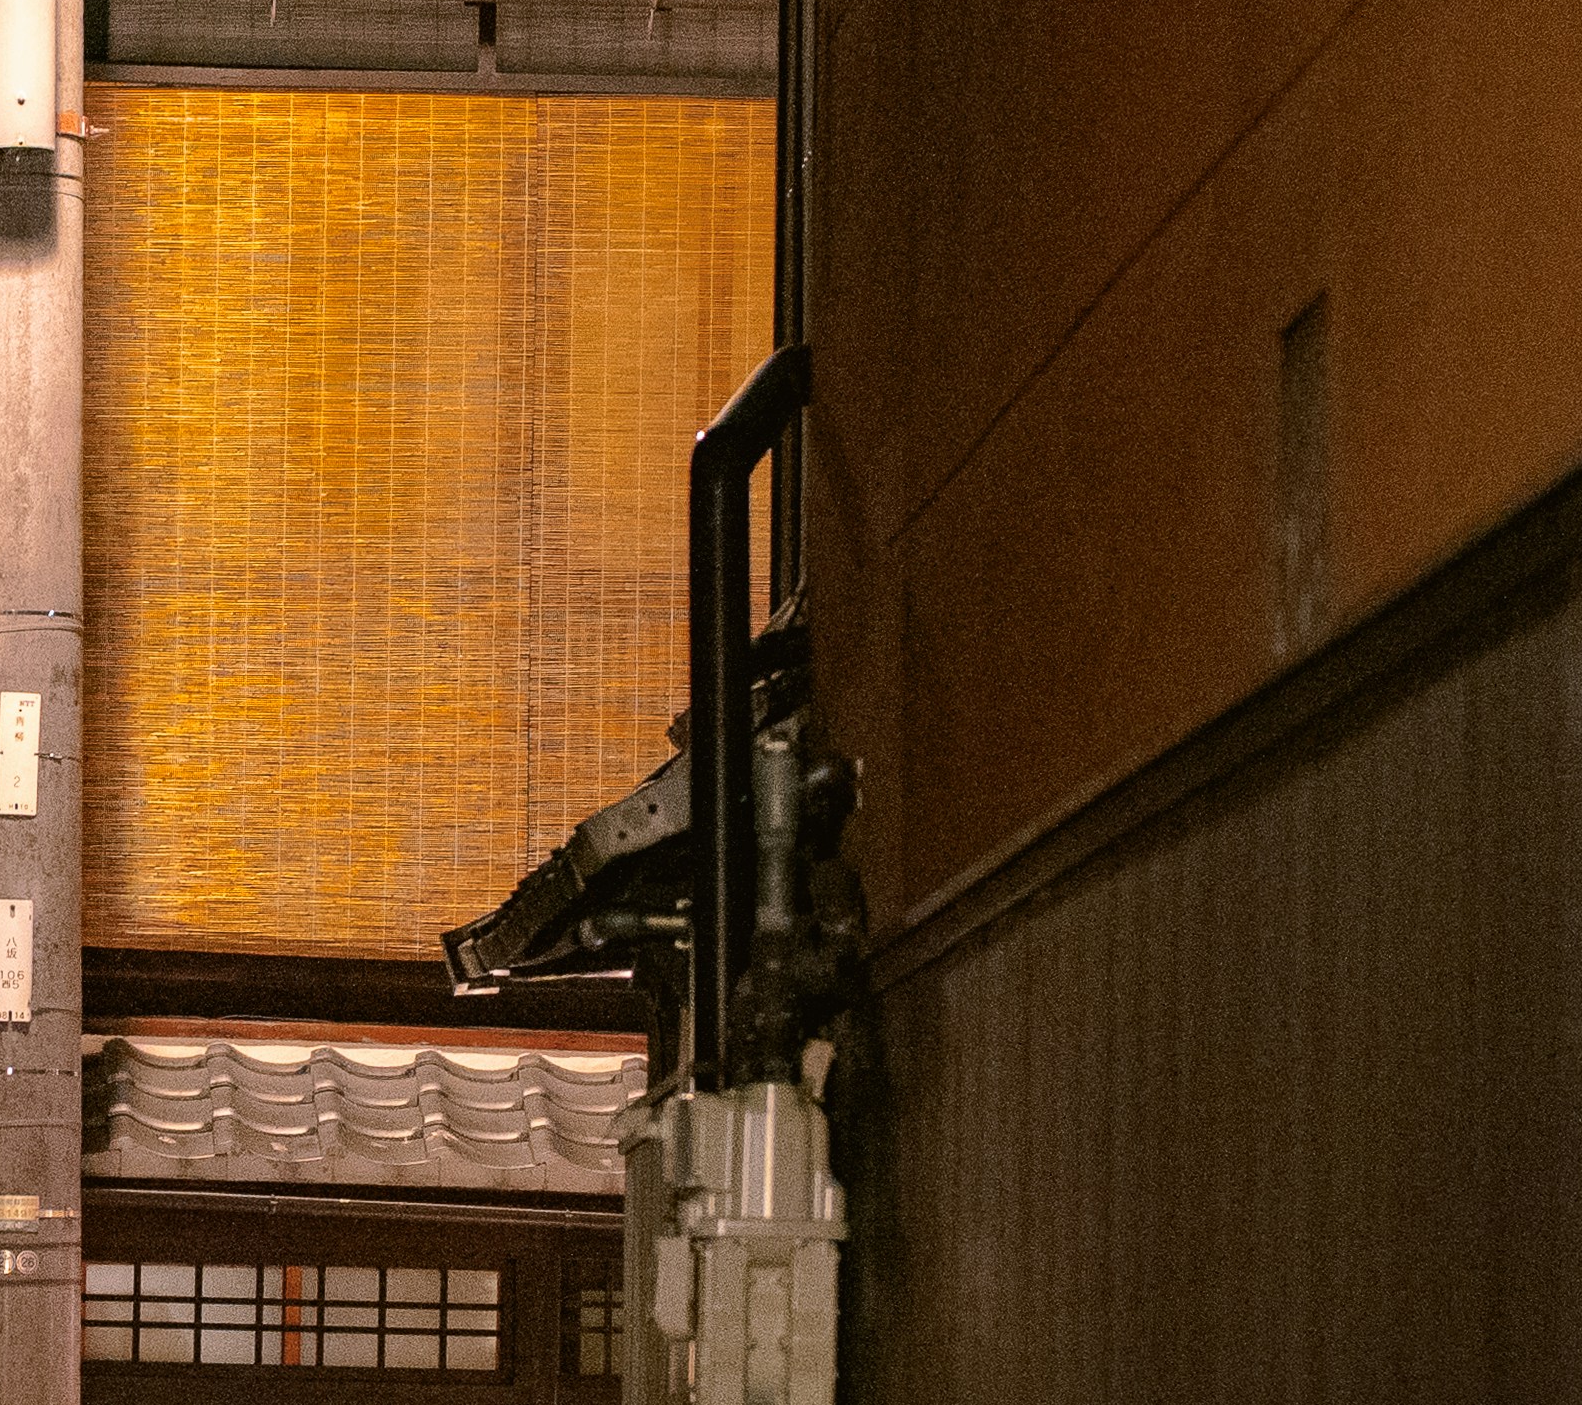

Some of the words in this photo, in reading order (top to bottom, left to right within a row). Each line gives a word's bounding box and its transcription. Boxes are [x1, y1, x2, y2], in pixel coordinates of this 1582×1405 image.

[13, 775, 21, 788] 2
[6, 937, 17, 959] 八坂
[0, 970, 25, 980] 106
